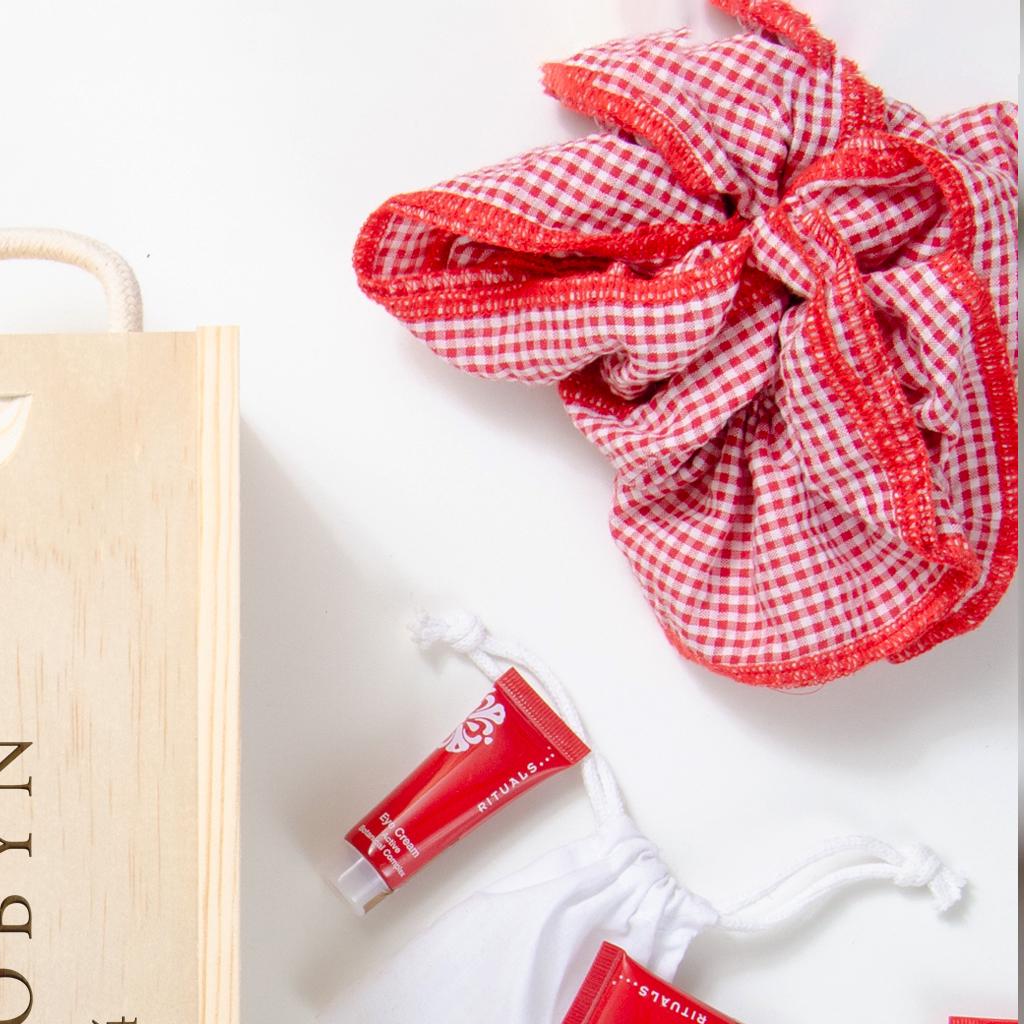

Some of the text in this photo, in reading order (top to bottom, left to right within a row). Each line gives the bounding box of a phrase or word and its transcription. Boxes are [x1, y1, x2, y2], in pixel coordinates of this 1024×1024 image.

[379, 812, 420, 858] Eye Cream
[382, 832, 401, 854] Active
